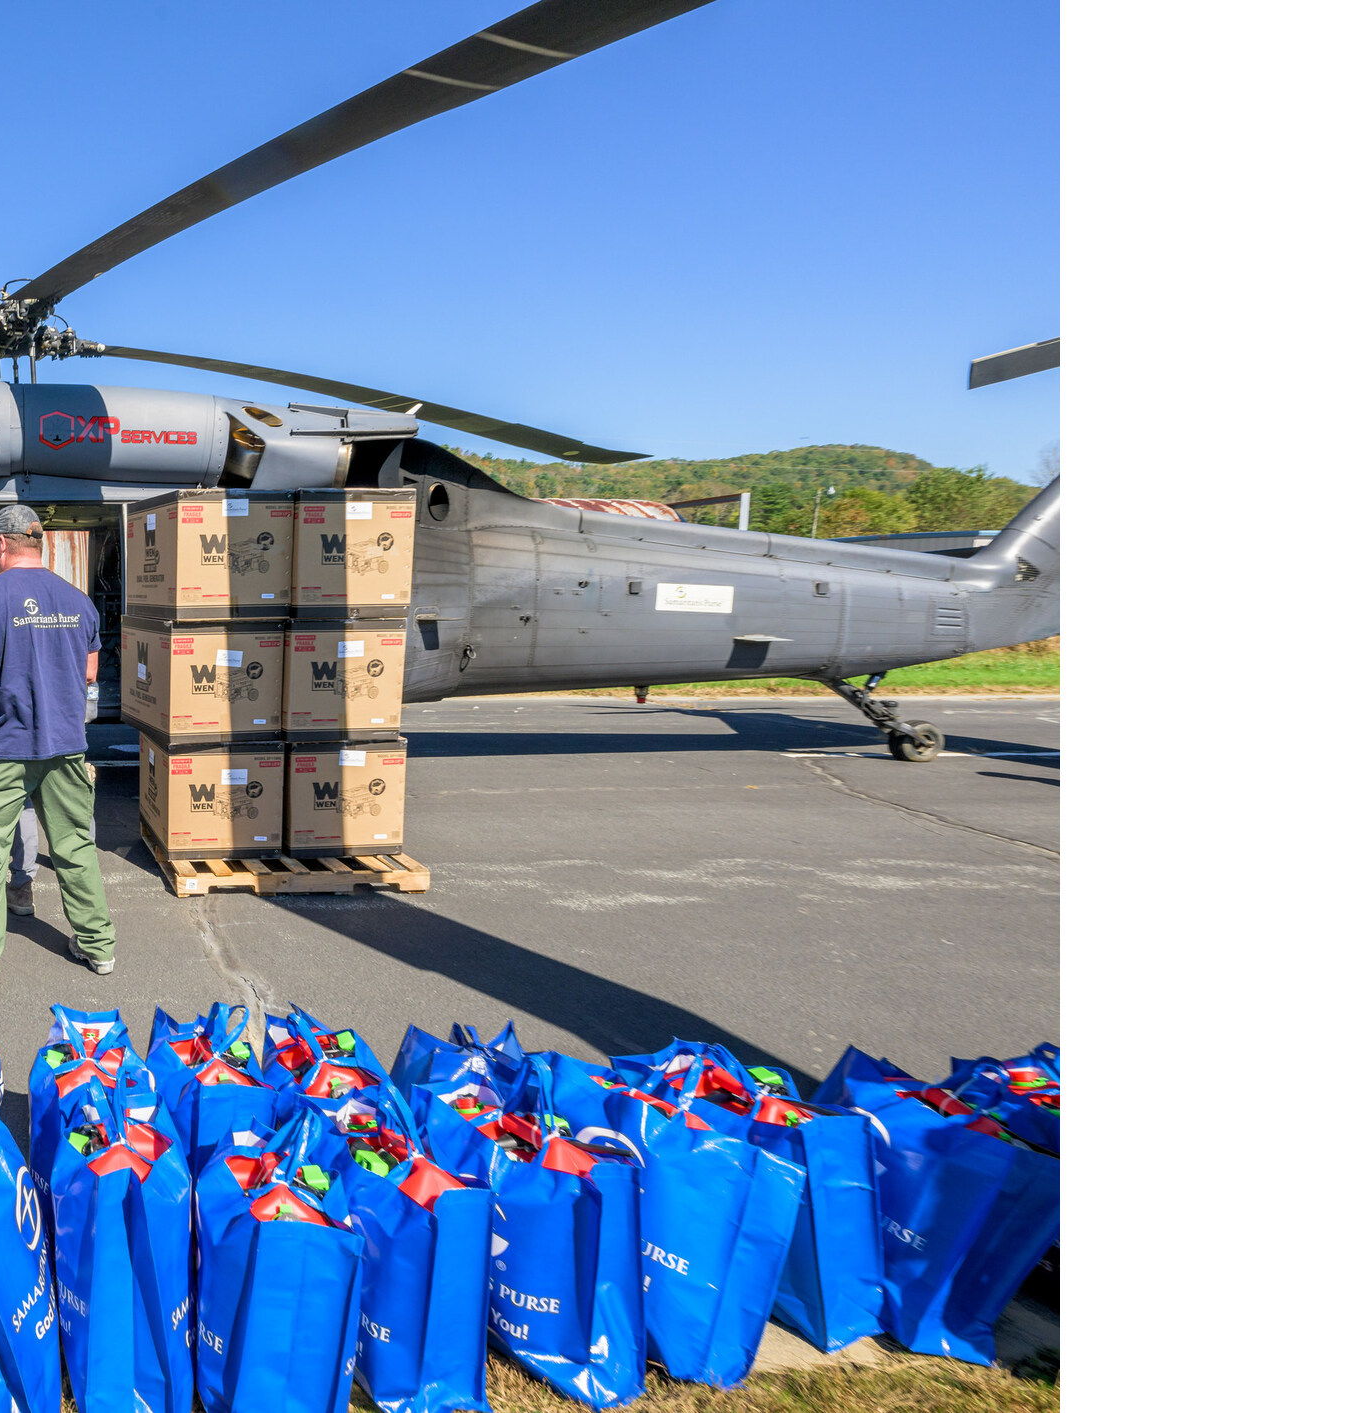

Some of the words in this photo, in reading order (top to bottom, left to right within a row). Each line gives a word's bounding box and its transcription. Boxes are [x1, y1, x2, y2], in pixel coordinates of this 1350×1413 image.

[120, 429, 198, 445] SERVICES
[203, 555, 224, 563] WEN
[323, 555, 345, 563] WEN
[193, 684, 215, 692] WEN
[313, 681, 334, 689] WEN
[192, 802, 214, 810] WEN
[315, 800, 337, 808] WEN
[499, 1283, 561, 1315] PURSE
[491, 1306, 530, 1341] You!
